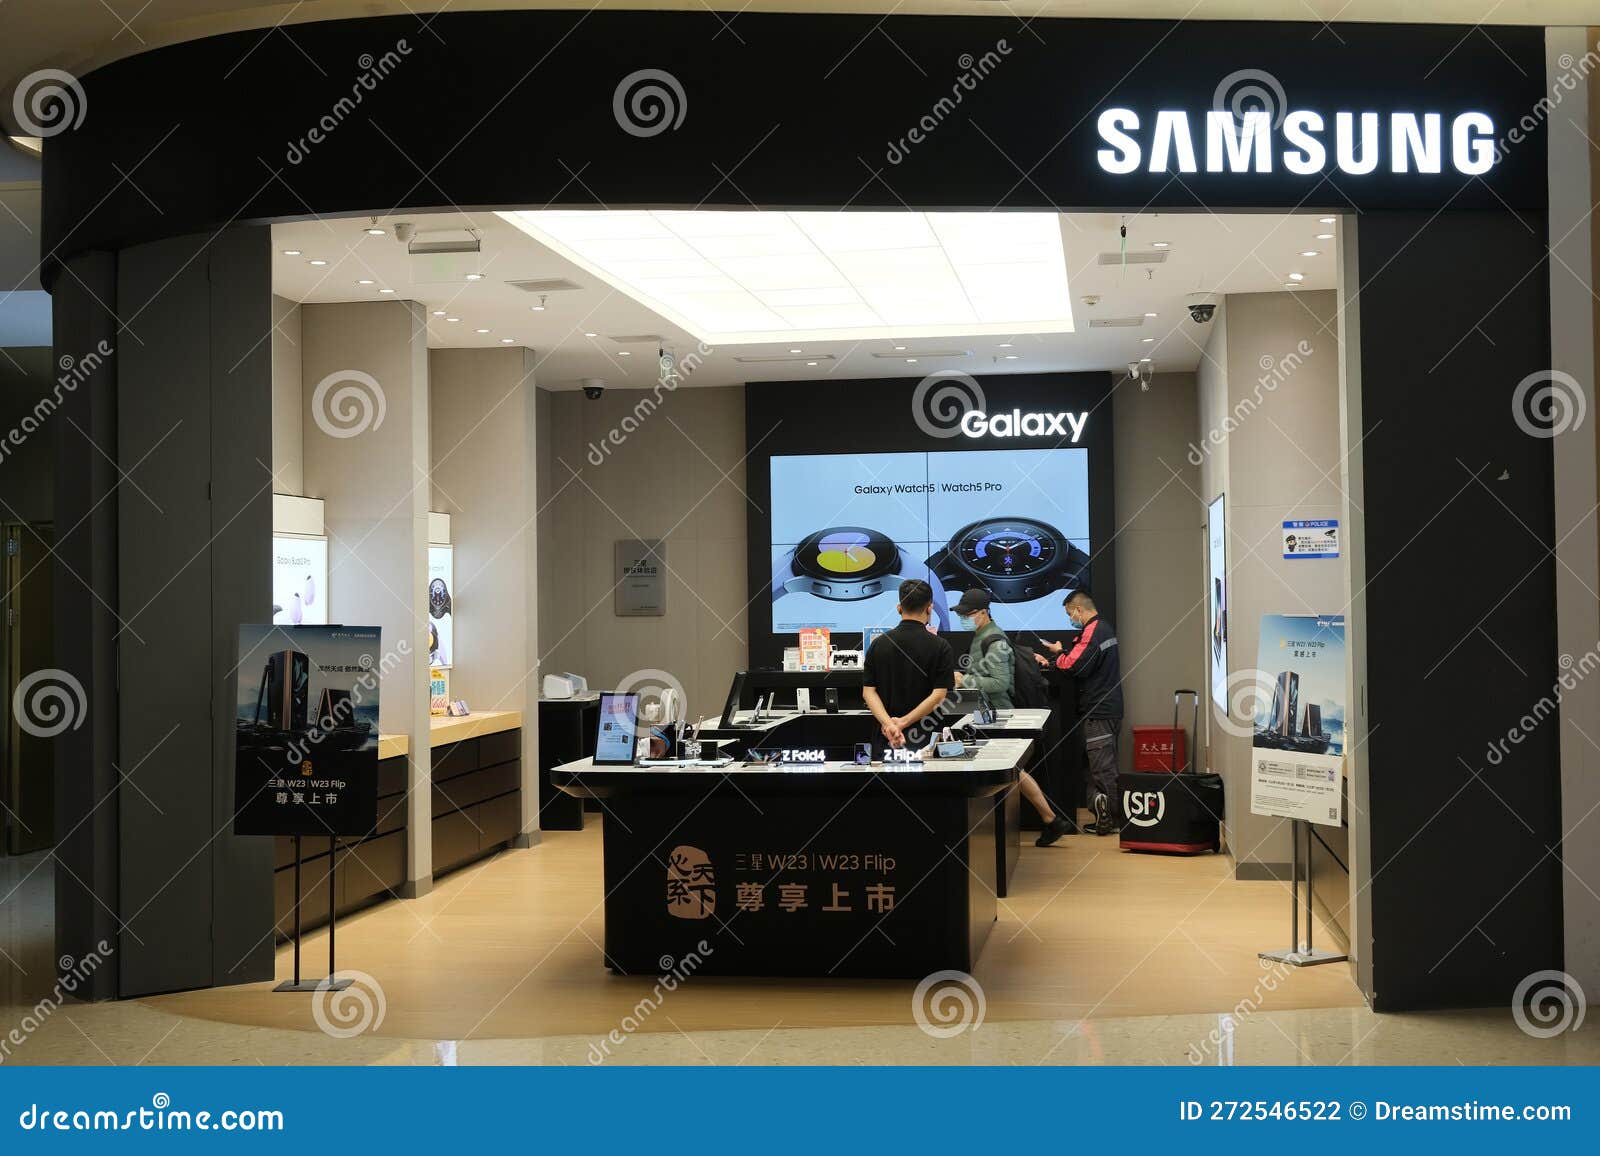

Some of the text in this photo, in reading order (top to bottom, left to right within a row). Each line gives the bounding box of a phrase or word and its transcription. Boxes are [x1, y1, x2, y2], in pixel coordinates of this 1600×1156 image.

[1097, 108, 1496, 175] SAMSUNG
[960, 409, 1088, 442] Galaxy
[854, 483, 1002, 495] Galaxy Watch5 Watch5 Pro
[782, 750, 826, 761] Z Fold4
[883, 749, 923, 763] Z Flip4
[287, 780, 306, 788] W23
[311, 780, 329, 788] W23
[330, 780, 346, 789] Flip
[275, 792, 338, 805] 尊享上市
[735, 853, 896, 875] 三星 W23 W23 Flip
[735, 882, 897, 913] 尊享上市
